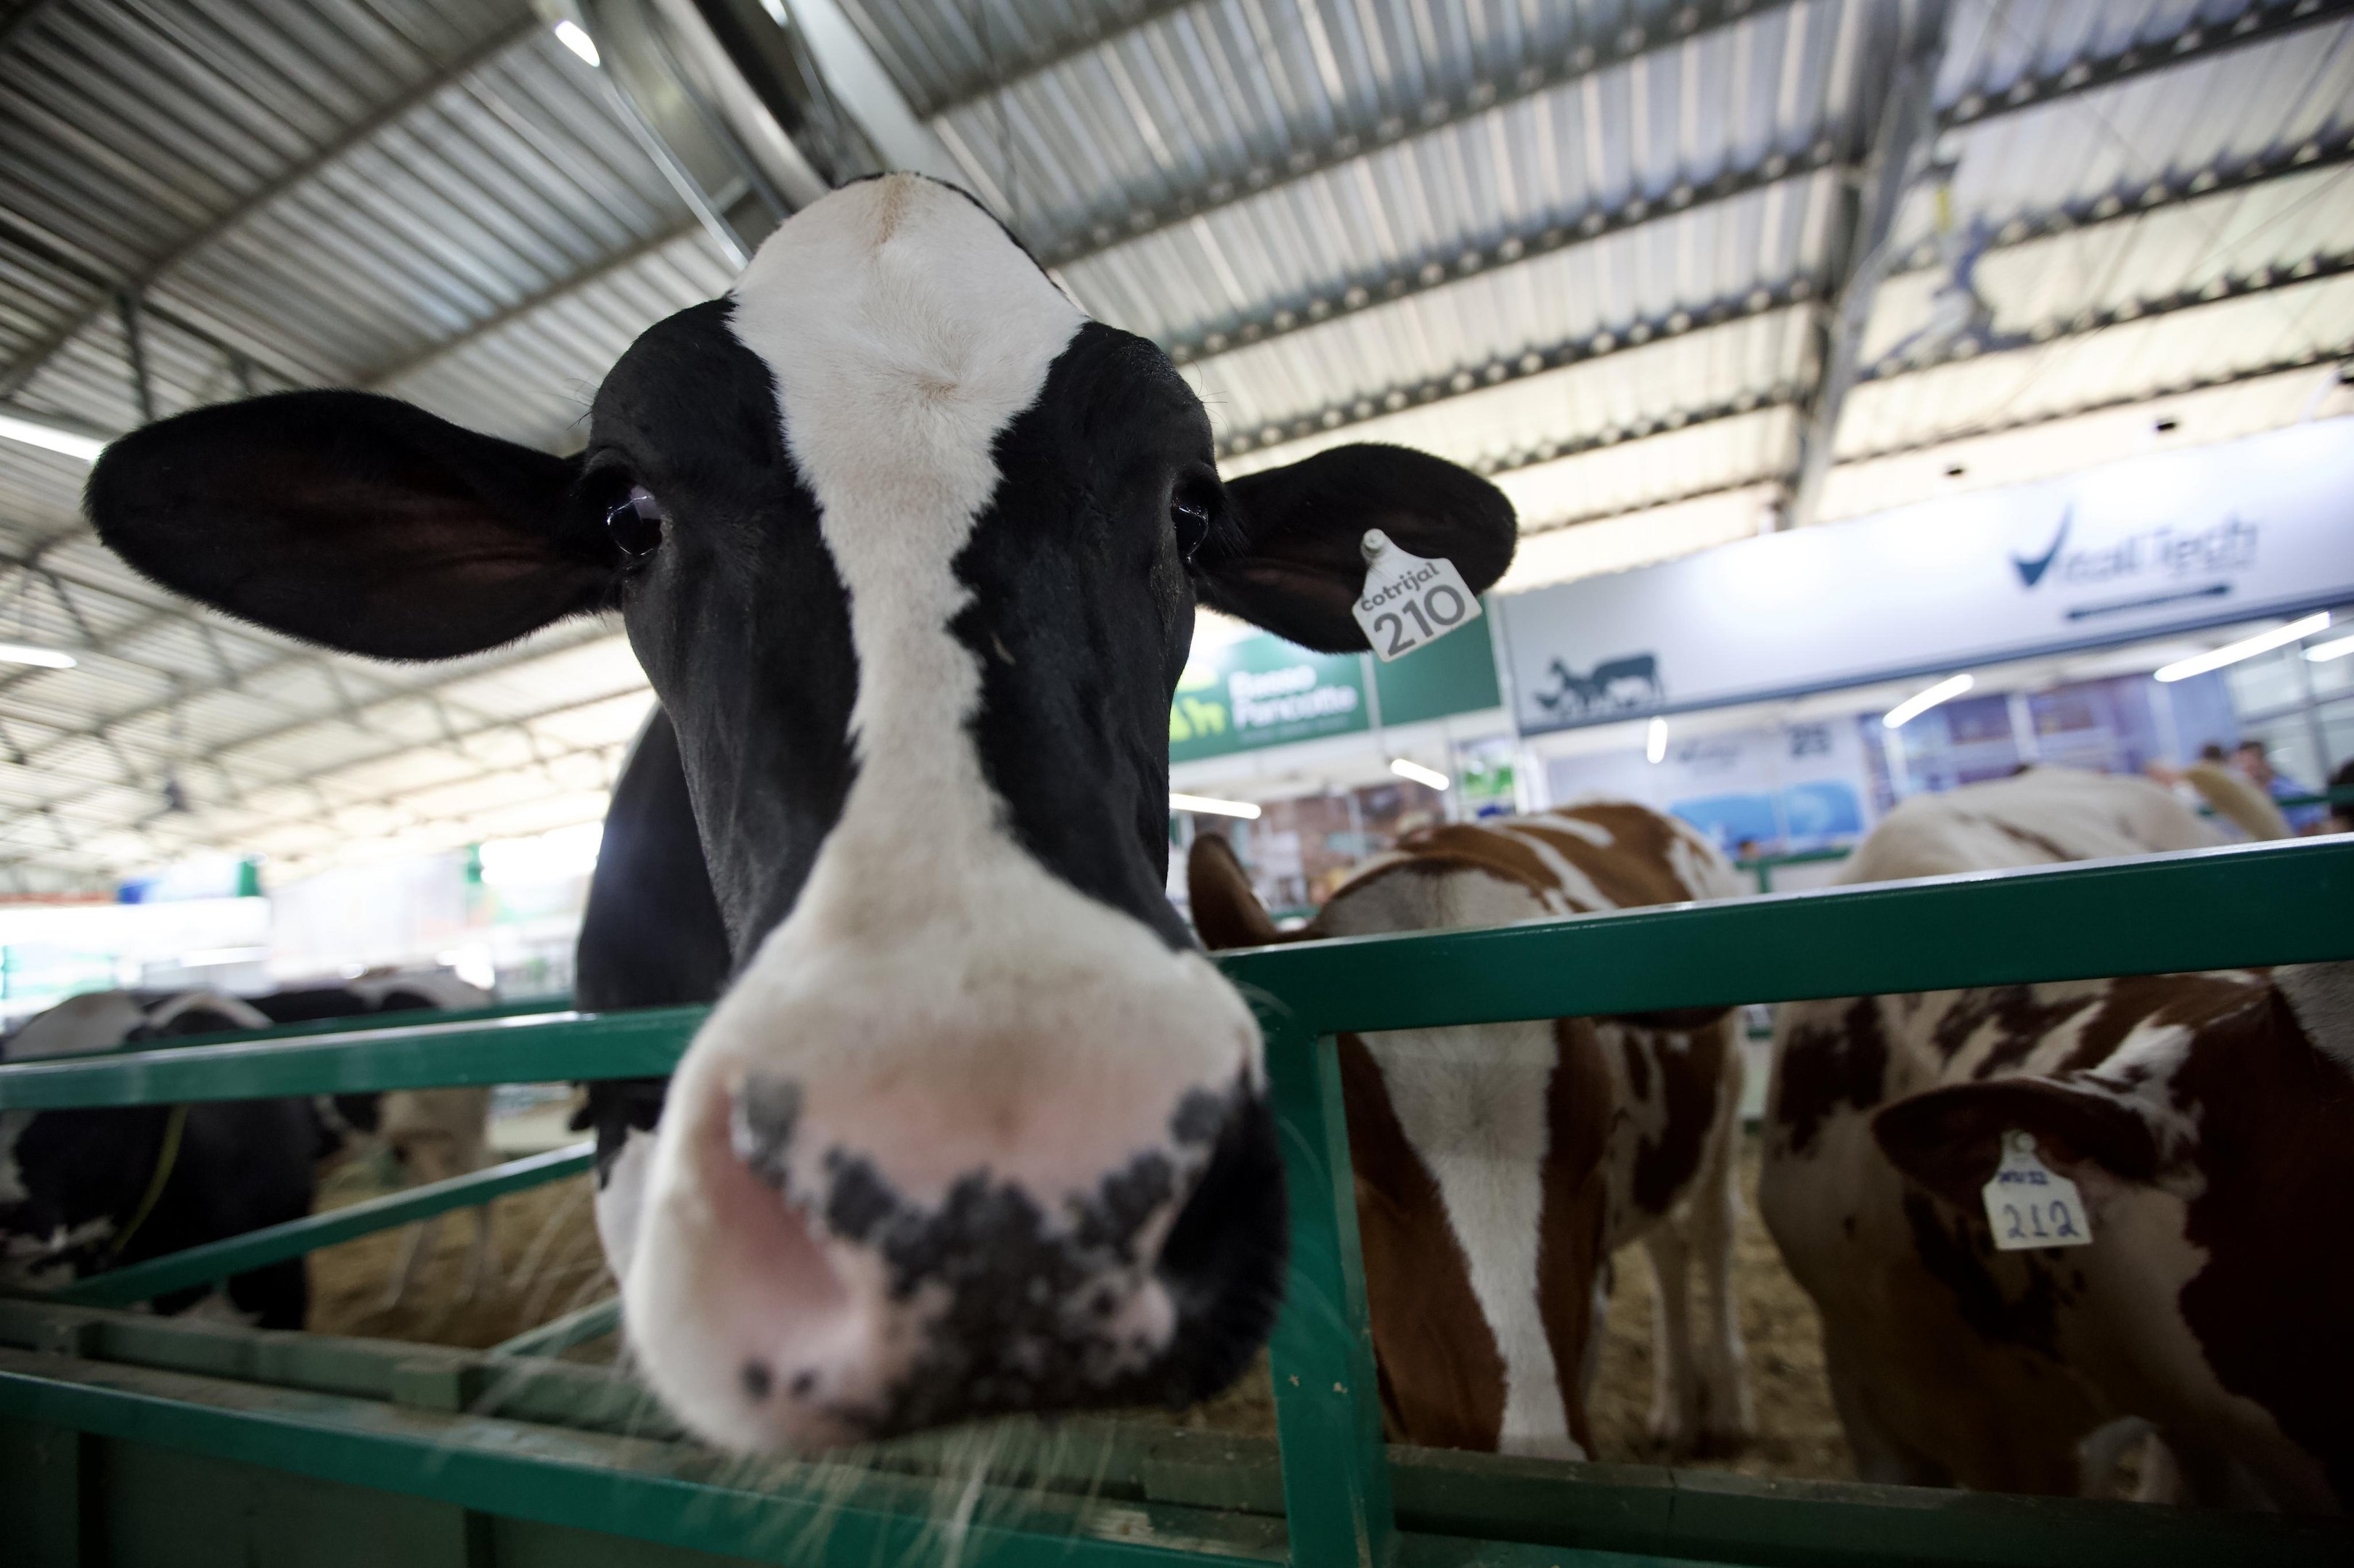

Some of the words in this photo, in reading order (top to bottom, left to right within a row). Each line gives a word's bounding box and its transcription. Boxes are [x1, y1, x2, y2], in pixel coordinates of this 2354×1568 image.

[1360, 561, 1440, 612] cotrijal
[1373, 584, 1466, 657] 210
[2003, 1199, 2081, 1239] 212
